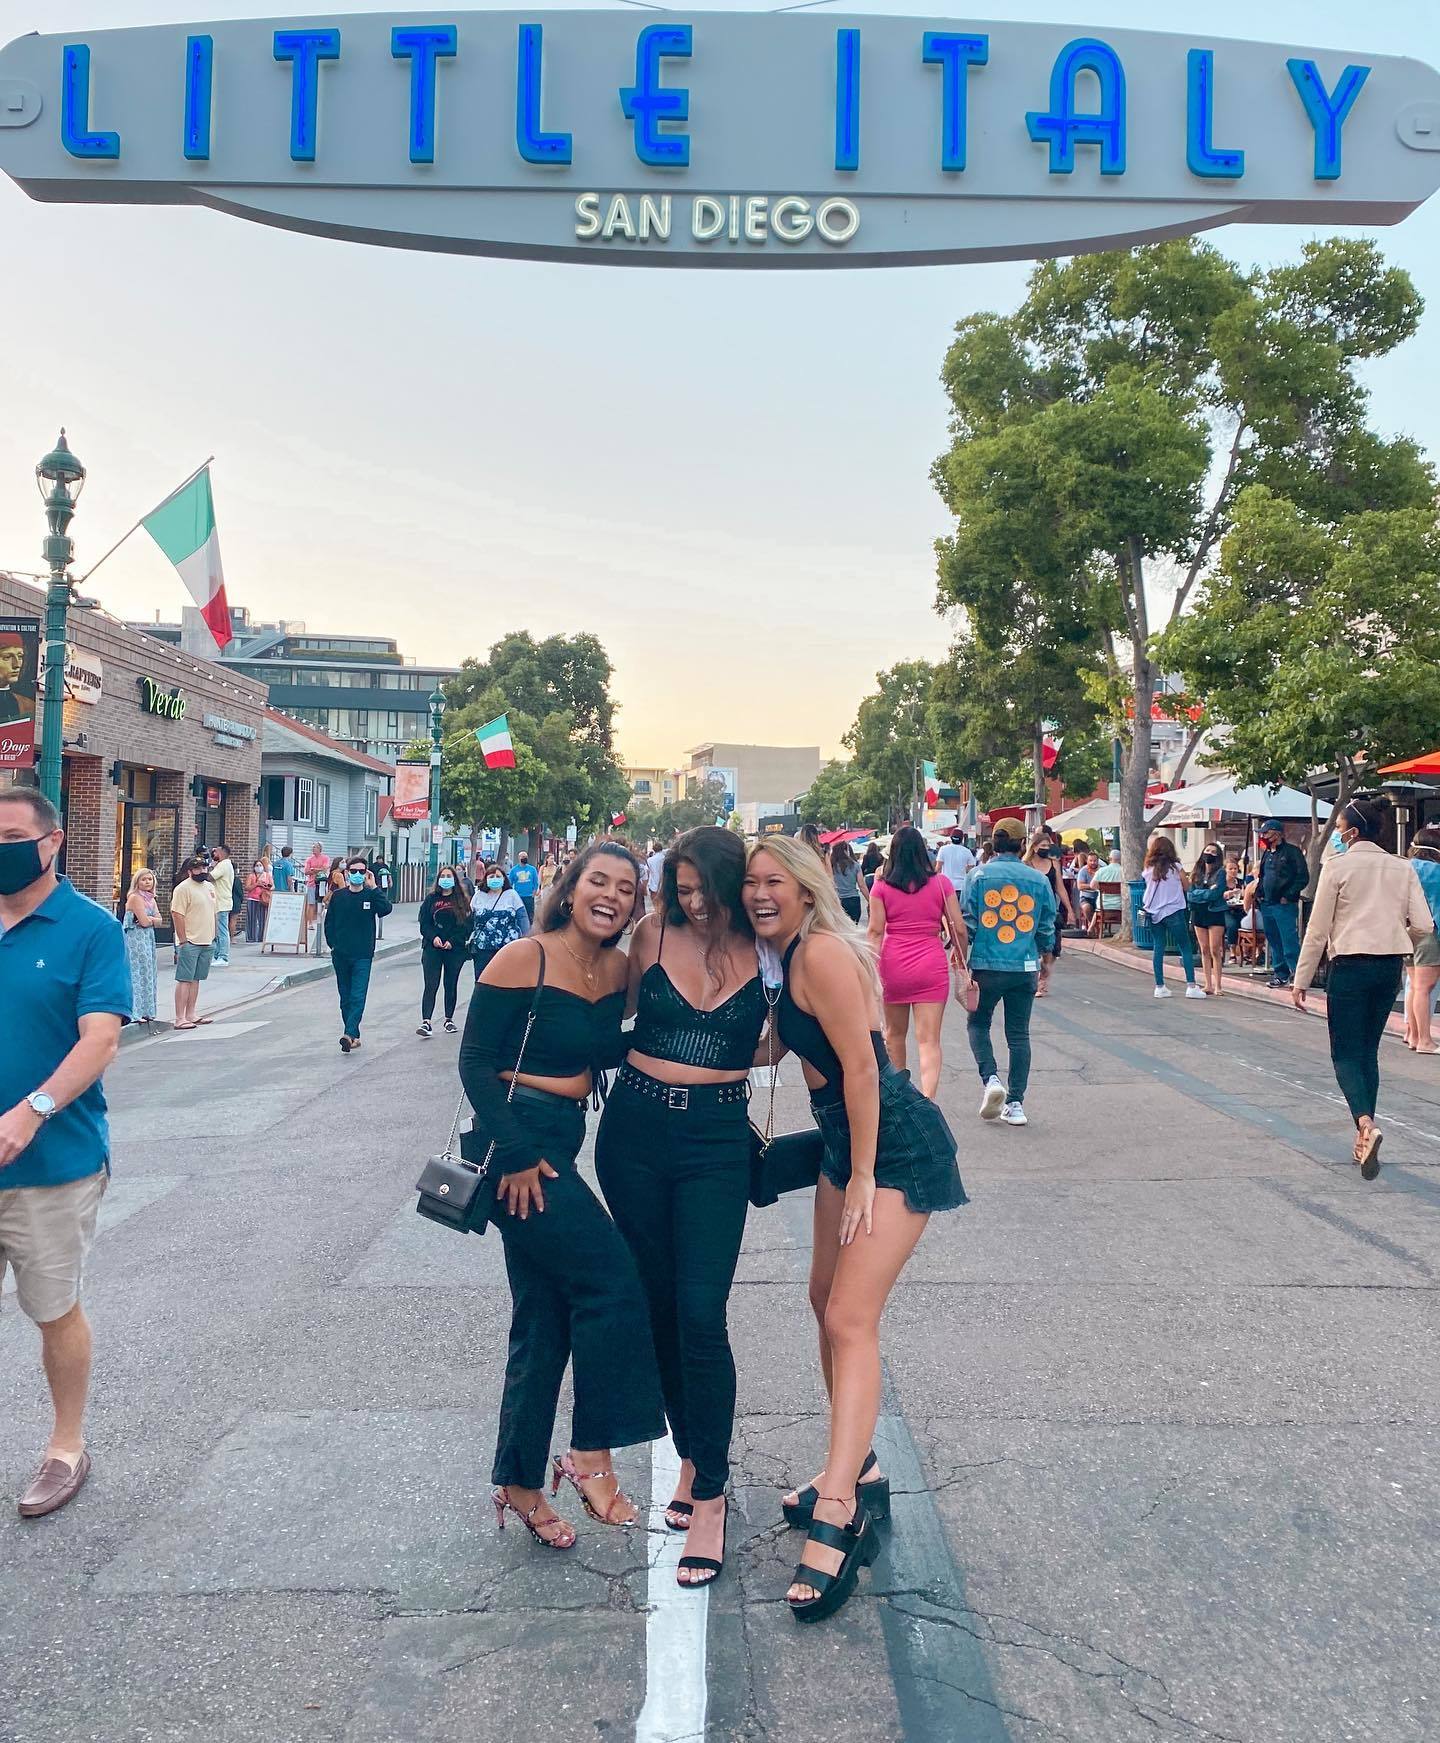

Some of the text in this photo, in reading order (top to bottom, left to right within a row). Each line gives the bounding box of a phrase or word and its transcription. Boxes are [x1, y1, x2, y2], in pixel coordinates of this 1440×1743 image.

[62, 24, 1371, 180] LITTLE ITALY
[574, 192, 860, 245] SAN DIEGO
[143, 676, 186, 720] Verde
[1, 738, 31, 757] Days
